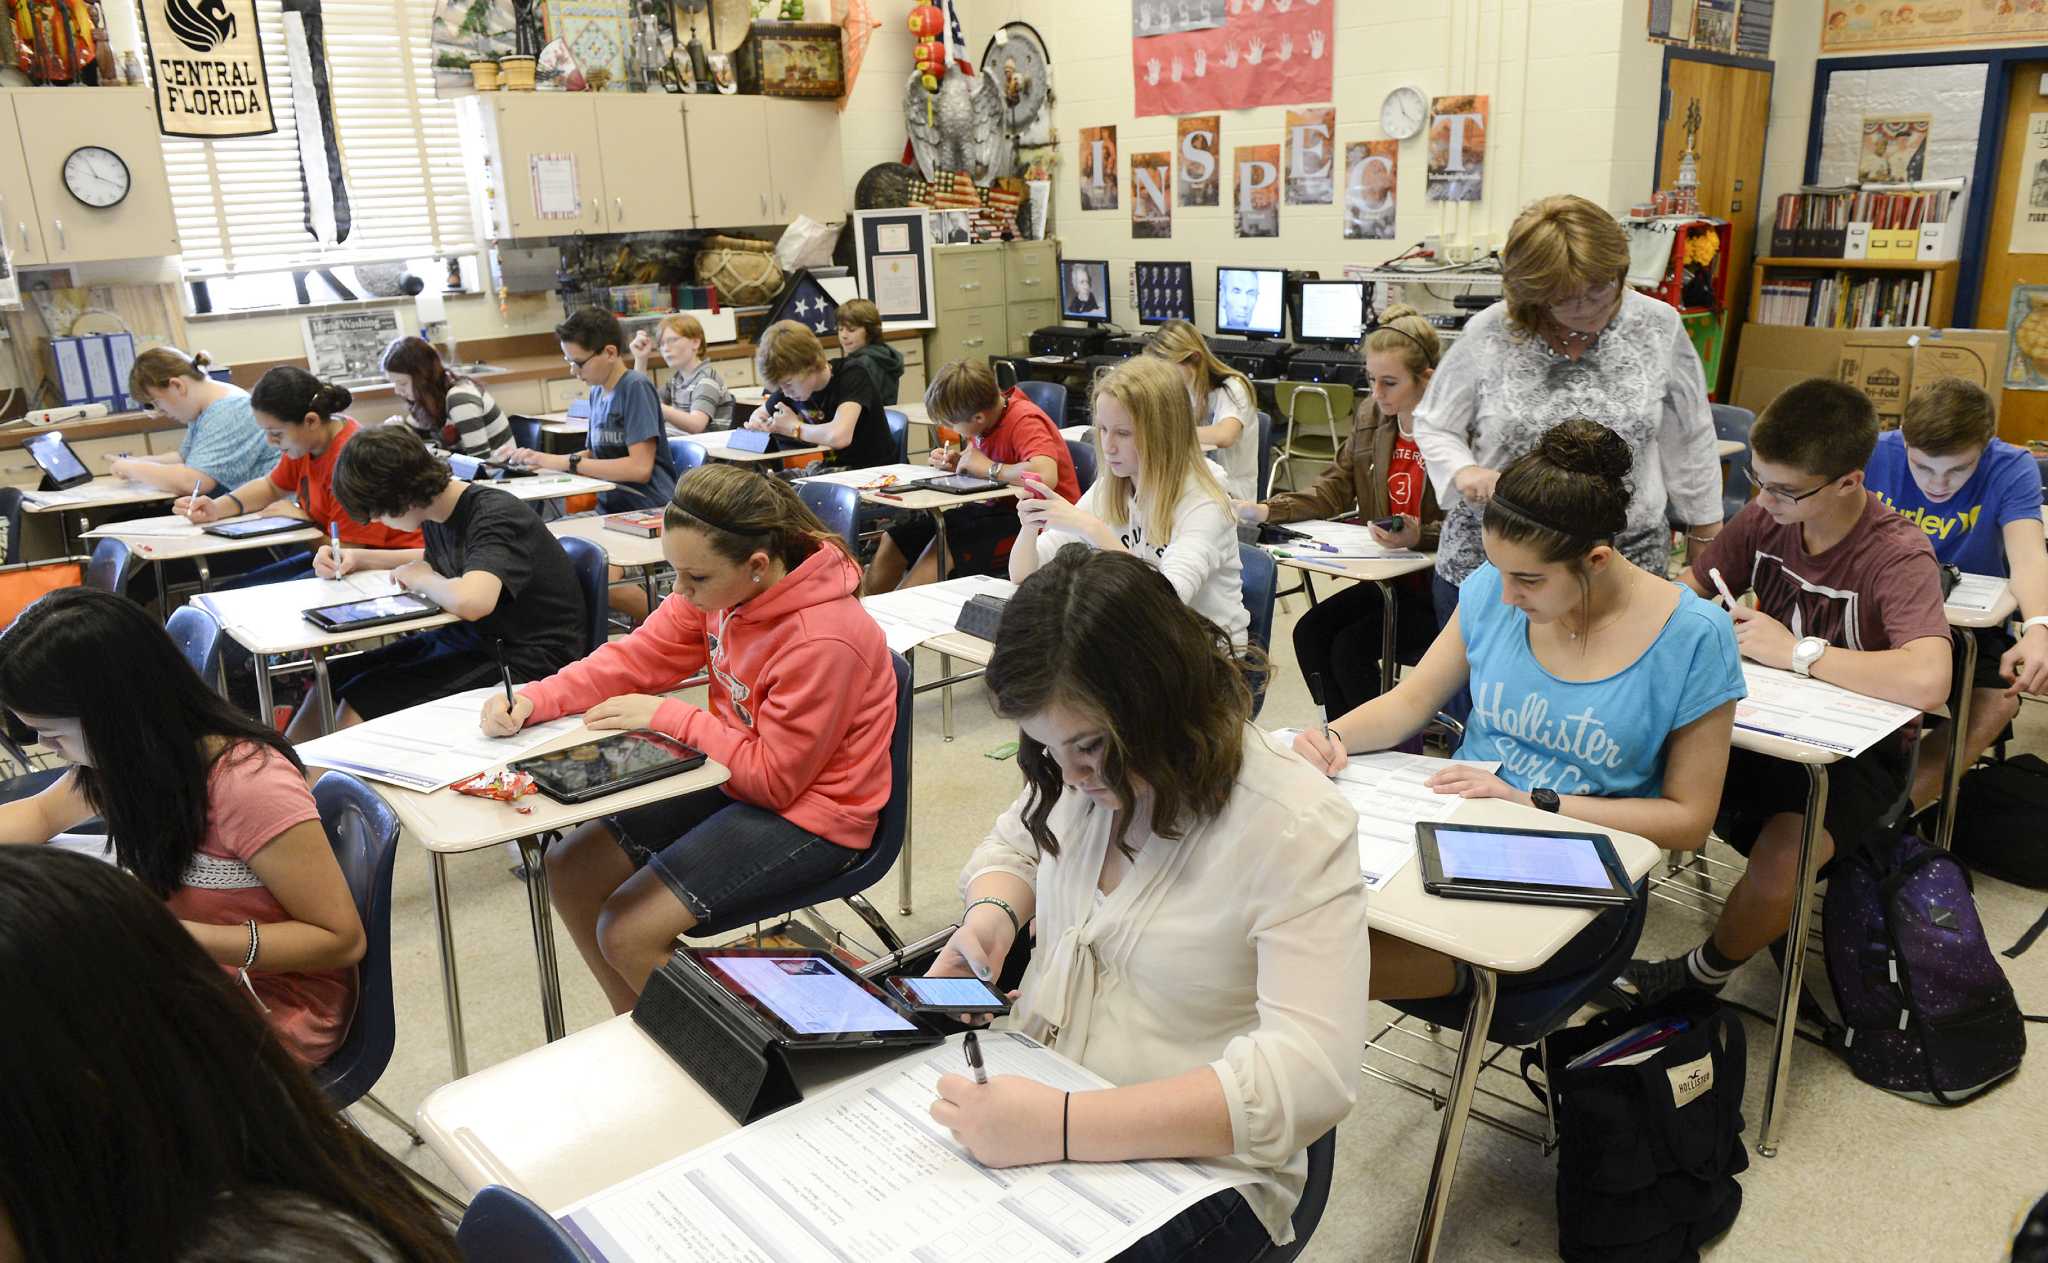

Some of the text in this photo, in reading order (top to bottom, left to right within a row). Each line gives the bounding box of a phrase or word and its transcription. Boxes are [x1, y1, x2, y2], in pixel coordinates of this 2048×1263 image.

[160, 59, 257, 86] CENTRAL
[166, 87, 261, 115] FLORIDA
[340, 317, 381, 330] Washing
[1396, 481, 1406, 495] 2
[1475, 682, 1623, 768] Hollister
[1495, 737, 1558, 792] Surf
[1678, 1072, 1710, 1094] HOLLISTER
